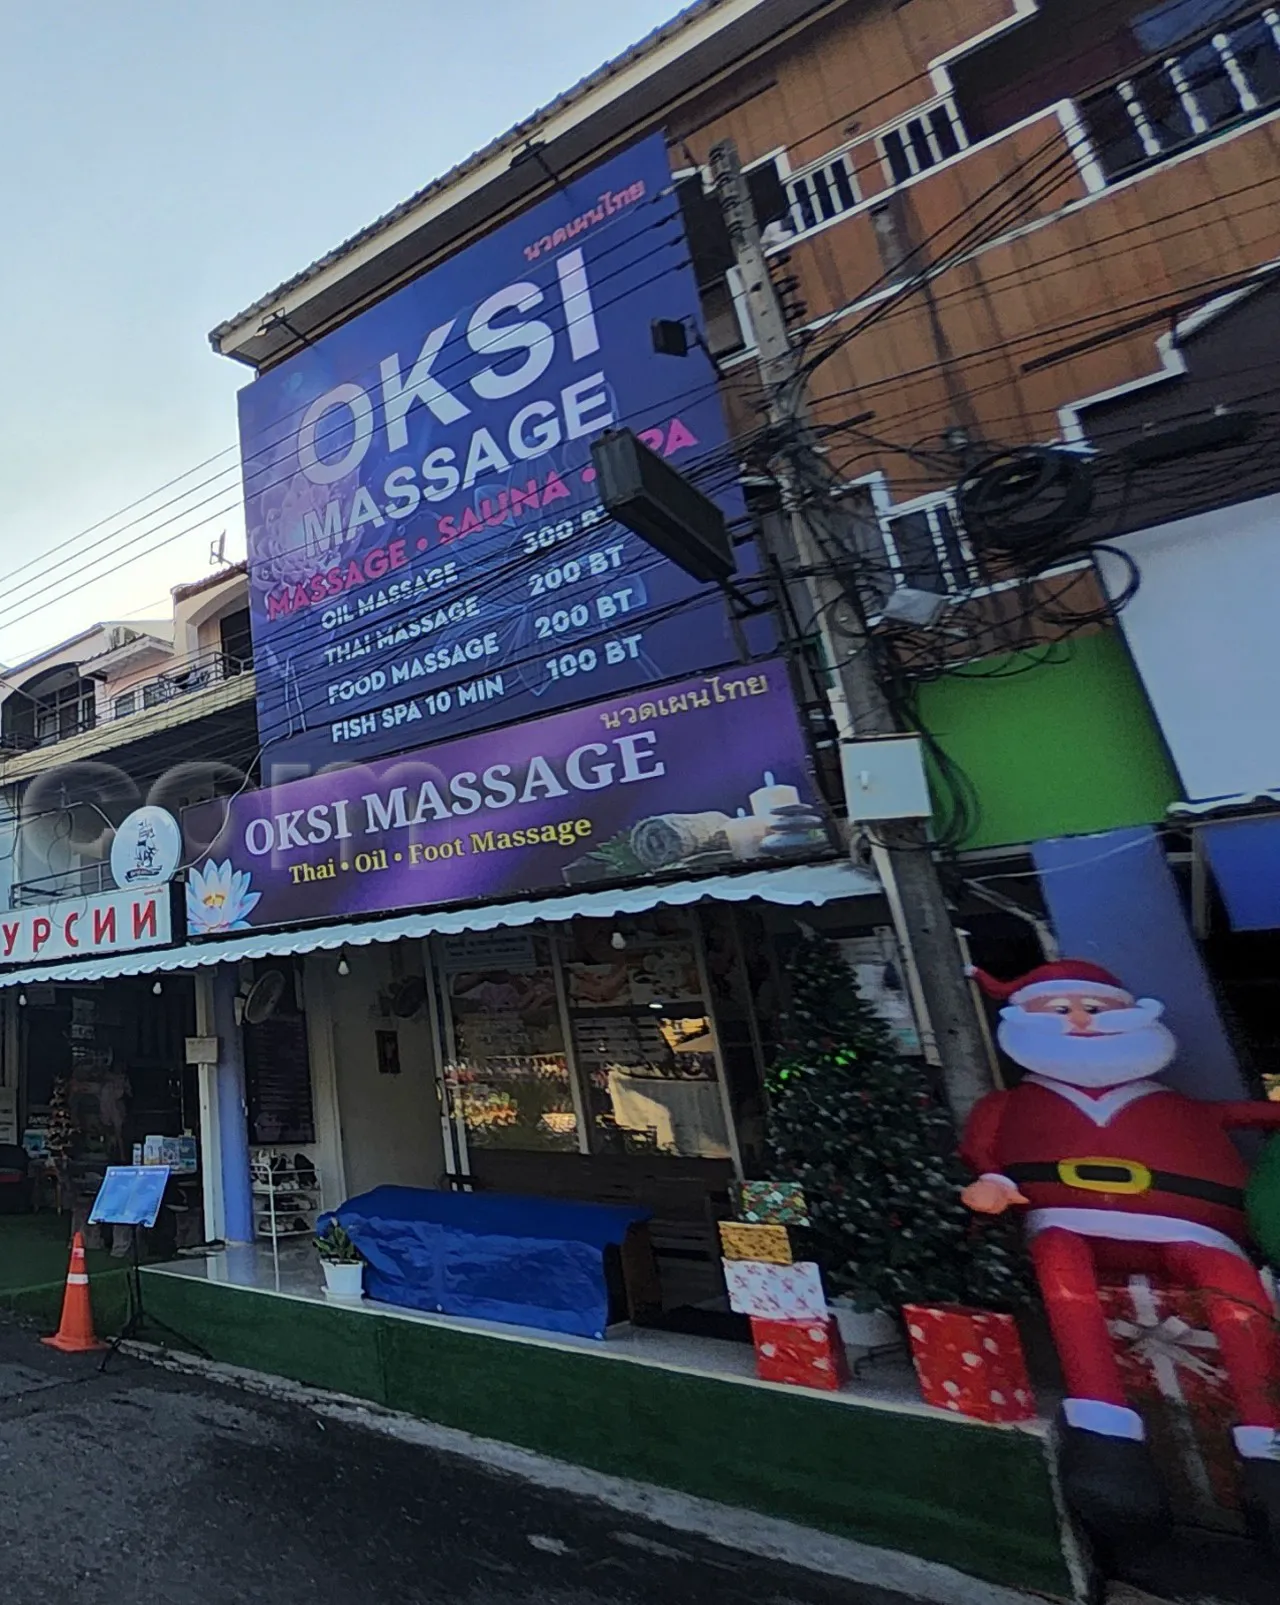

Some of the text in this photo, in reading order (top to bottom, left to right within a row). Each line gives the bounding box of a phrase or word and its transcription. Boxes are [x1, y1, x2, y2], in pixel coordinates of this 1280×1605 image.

[297, 247, 602, 487] OKSI
[268, 417, 699, 621] MASSAGE SAUNA PA
[301, 370, 614, 557] MASSAGE
[321, 610, 351, 630] OIL
[358, 561, 459, 614] MASSAGE
[522, 519, 574, 554] 300
[325, 543, 625, 667] THAI MASSAGE 200 BT
[328, 588, 635, 705] FOOD MASSAGE 200 BT
[331, 634, 644, 743] FISH SPA 10 MIN 100 BT
[245, 729, 666, 857] OKSI MASSAGE
[288, 815, 593, 885] Thai Oil Foot Massage
